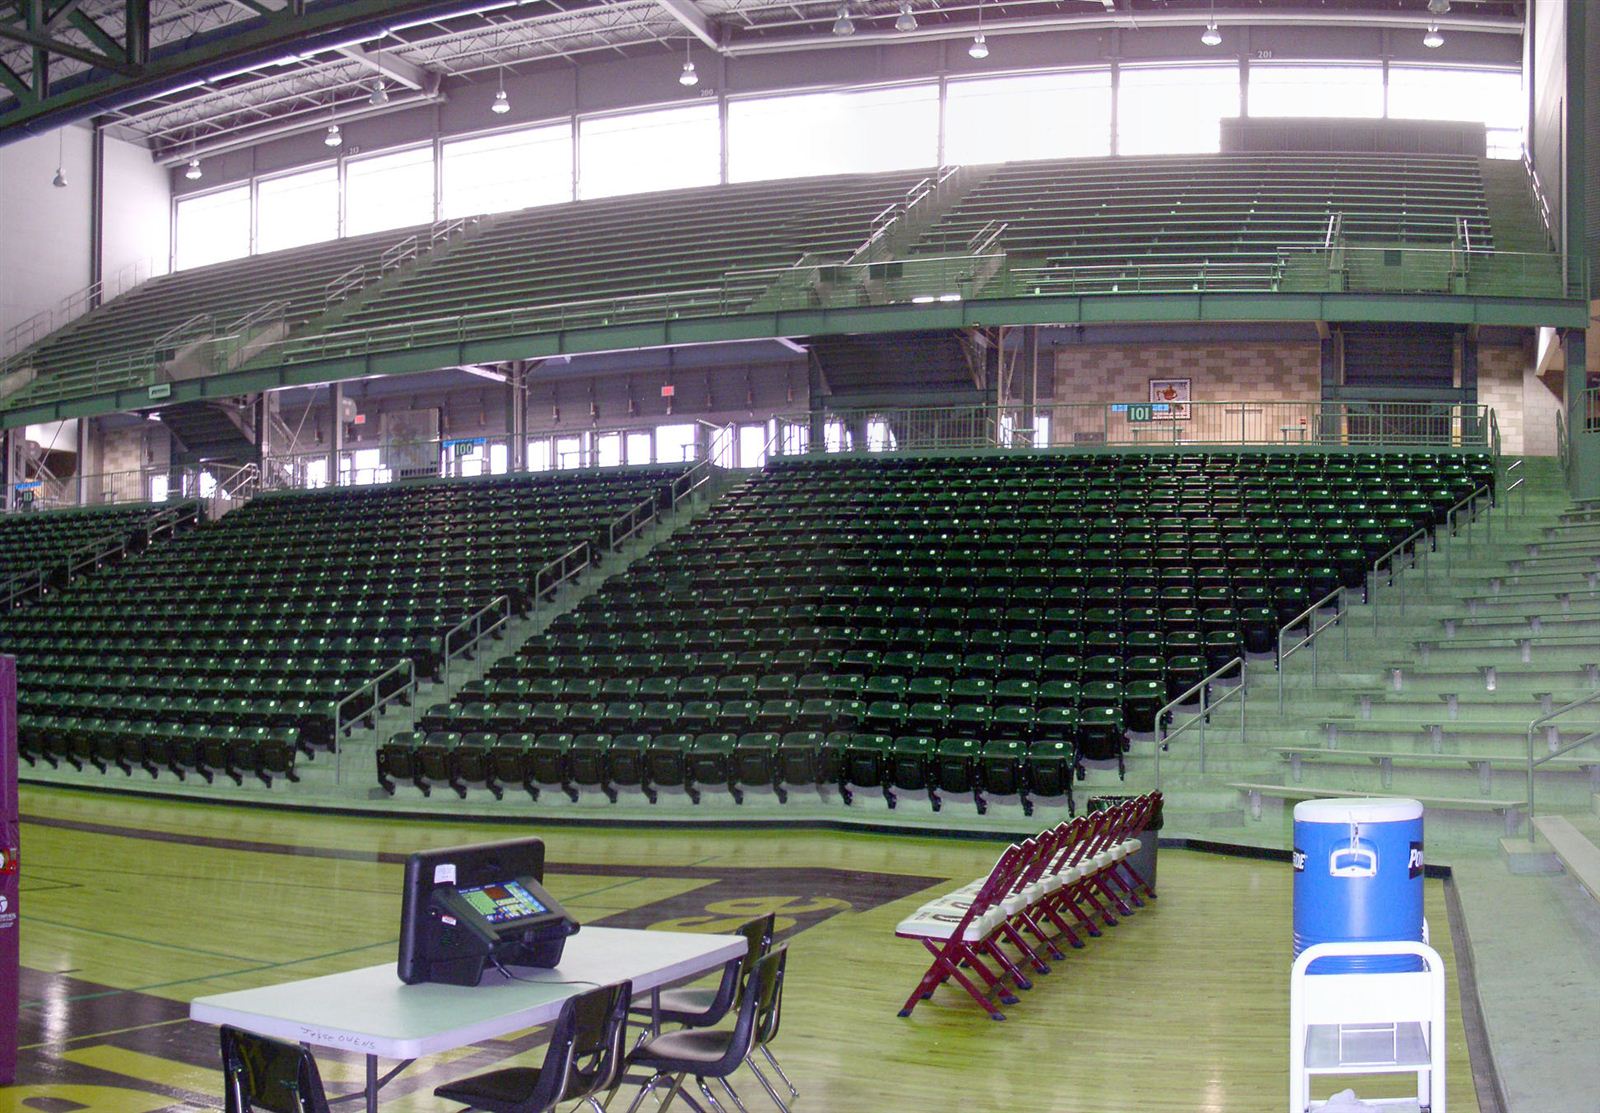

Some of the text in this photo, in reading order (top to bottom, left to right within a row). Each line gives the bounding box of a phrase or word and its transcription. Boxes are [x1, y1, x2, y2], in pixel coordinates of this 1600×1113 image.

[1258, 50, 1272, 58] 201
[1130, 408, 1150, 420] 101
[456, 443, 472, 456] 100
